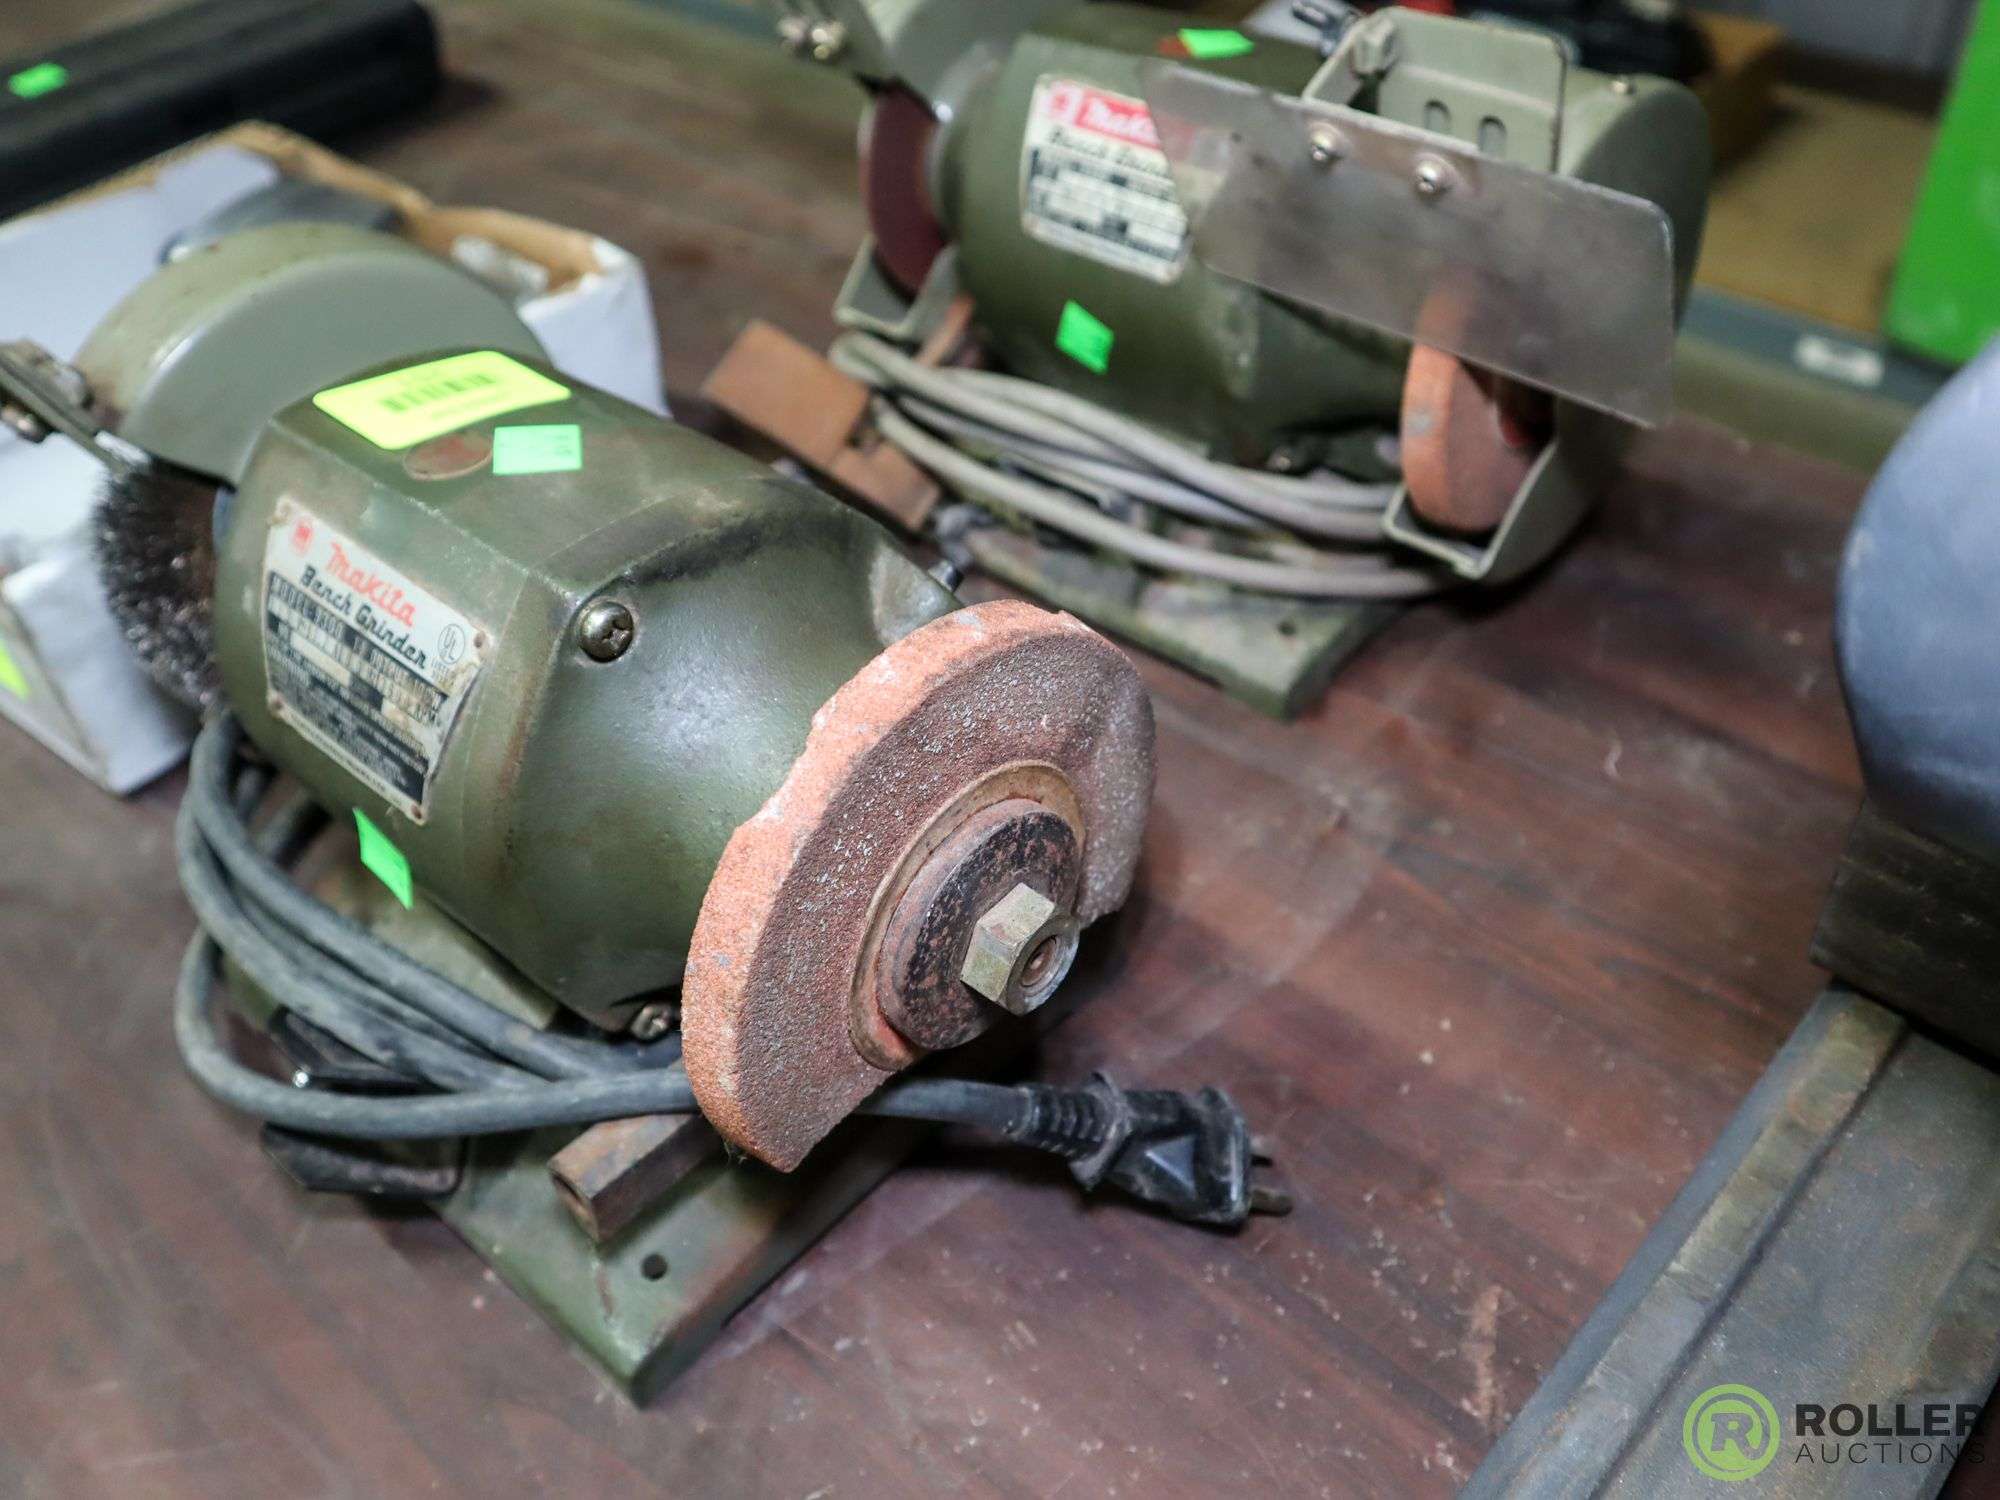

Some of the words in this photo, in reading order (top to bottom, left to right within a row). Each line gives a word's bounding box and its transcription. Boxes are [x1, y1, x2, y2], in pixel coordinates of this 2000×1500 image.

[300, 563, 351, 616] Bench
[355, 604, 427, 669] Grinder
[325, 541, 417, 628] Makita
